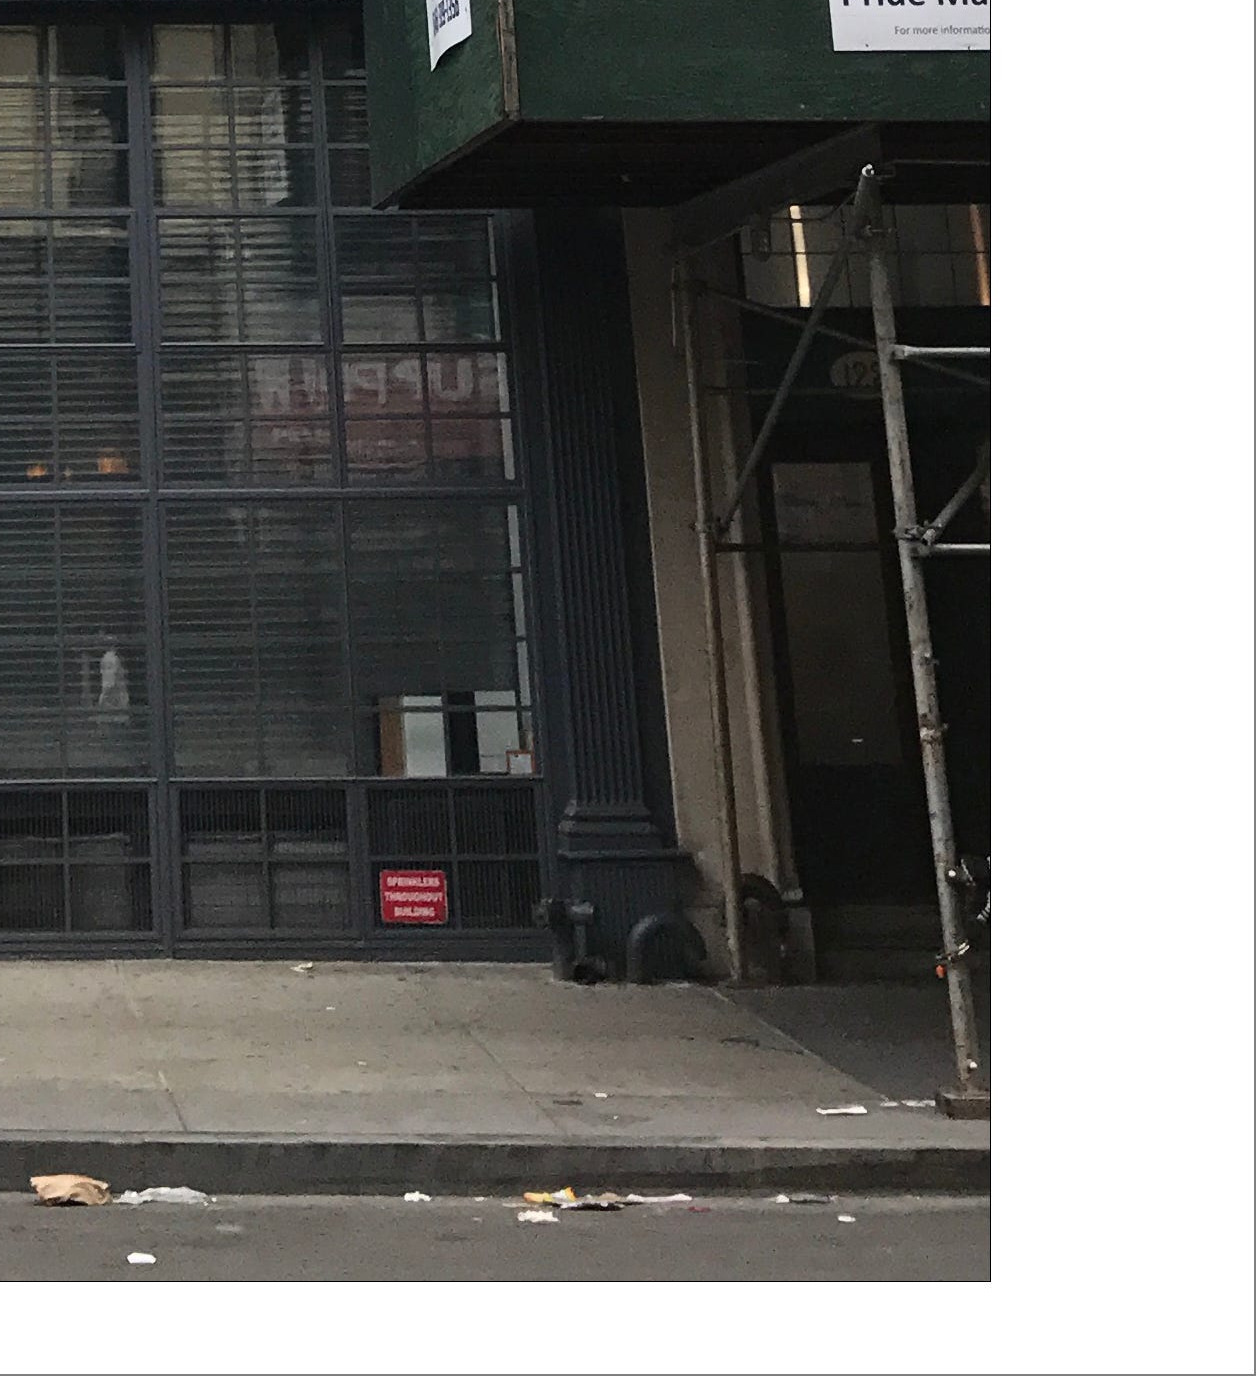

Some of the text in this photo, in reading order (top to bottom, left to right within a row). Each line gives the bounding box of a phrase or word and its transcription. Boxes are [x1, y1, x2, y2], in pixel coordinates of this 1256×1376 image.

[894, 26, 911, 35] For
[913, 27, 938, 35] more
[394, 906, 435, 917] BUILDING
